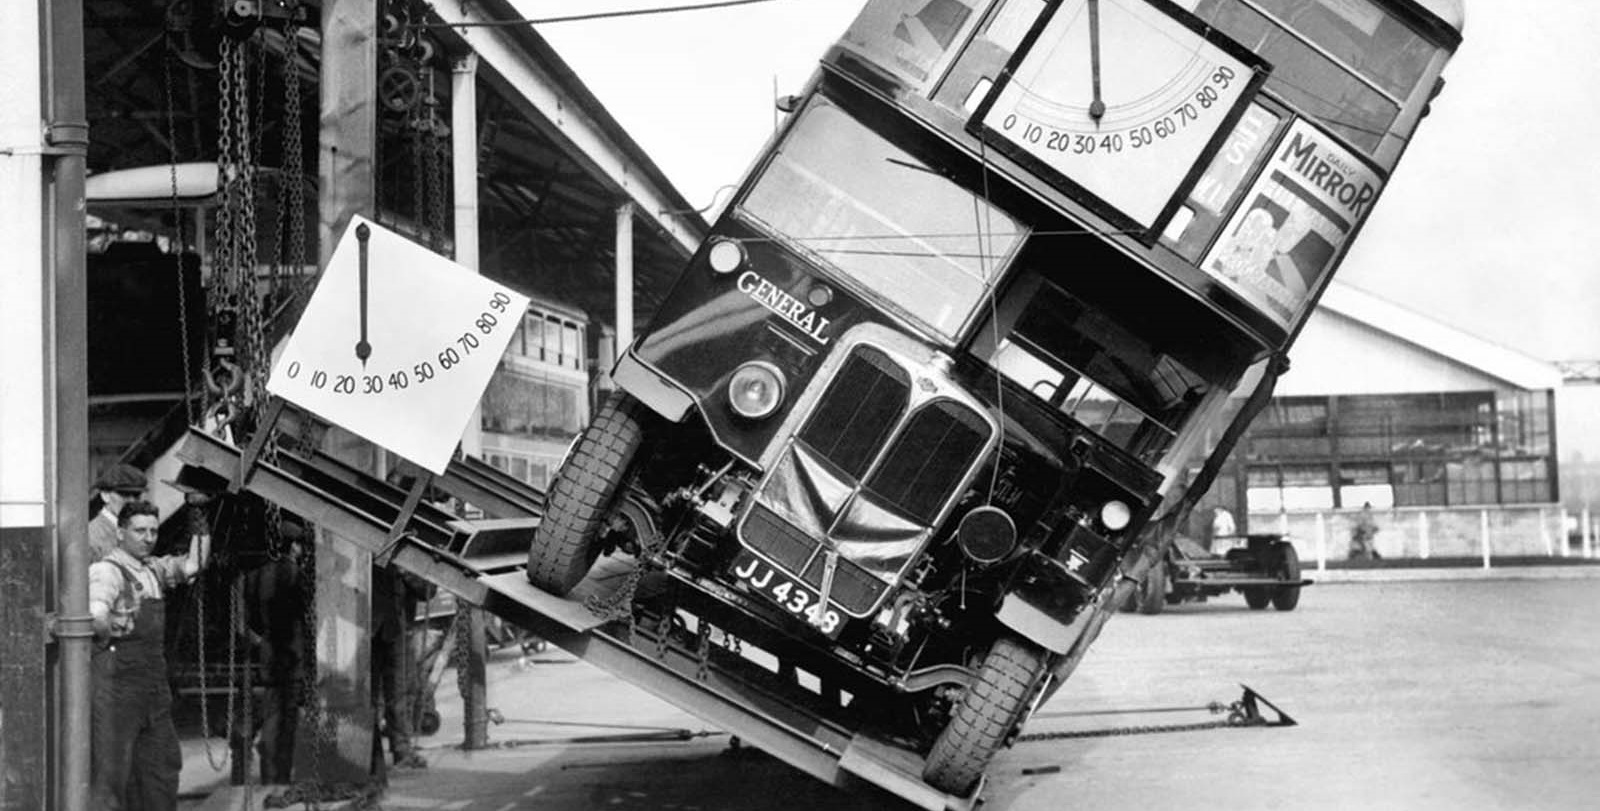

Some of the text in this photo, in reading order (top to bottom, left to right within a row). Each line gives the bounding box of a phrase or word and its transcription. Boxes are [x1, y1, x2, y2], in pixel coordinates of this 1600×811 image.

[1003, 65, 1236, 155] 0 10 20 30 40 50 60 70 80 90
[1327, 153, 1358, 177] DAILY
[287, 291, 511, 395] 0 10 20 30 40 50 60 70 80 90
[737, 270, 831, 345] GENERAL
[735, 560, 775, 588] JJ
